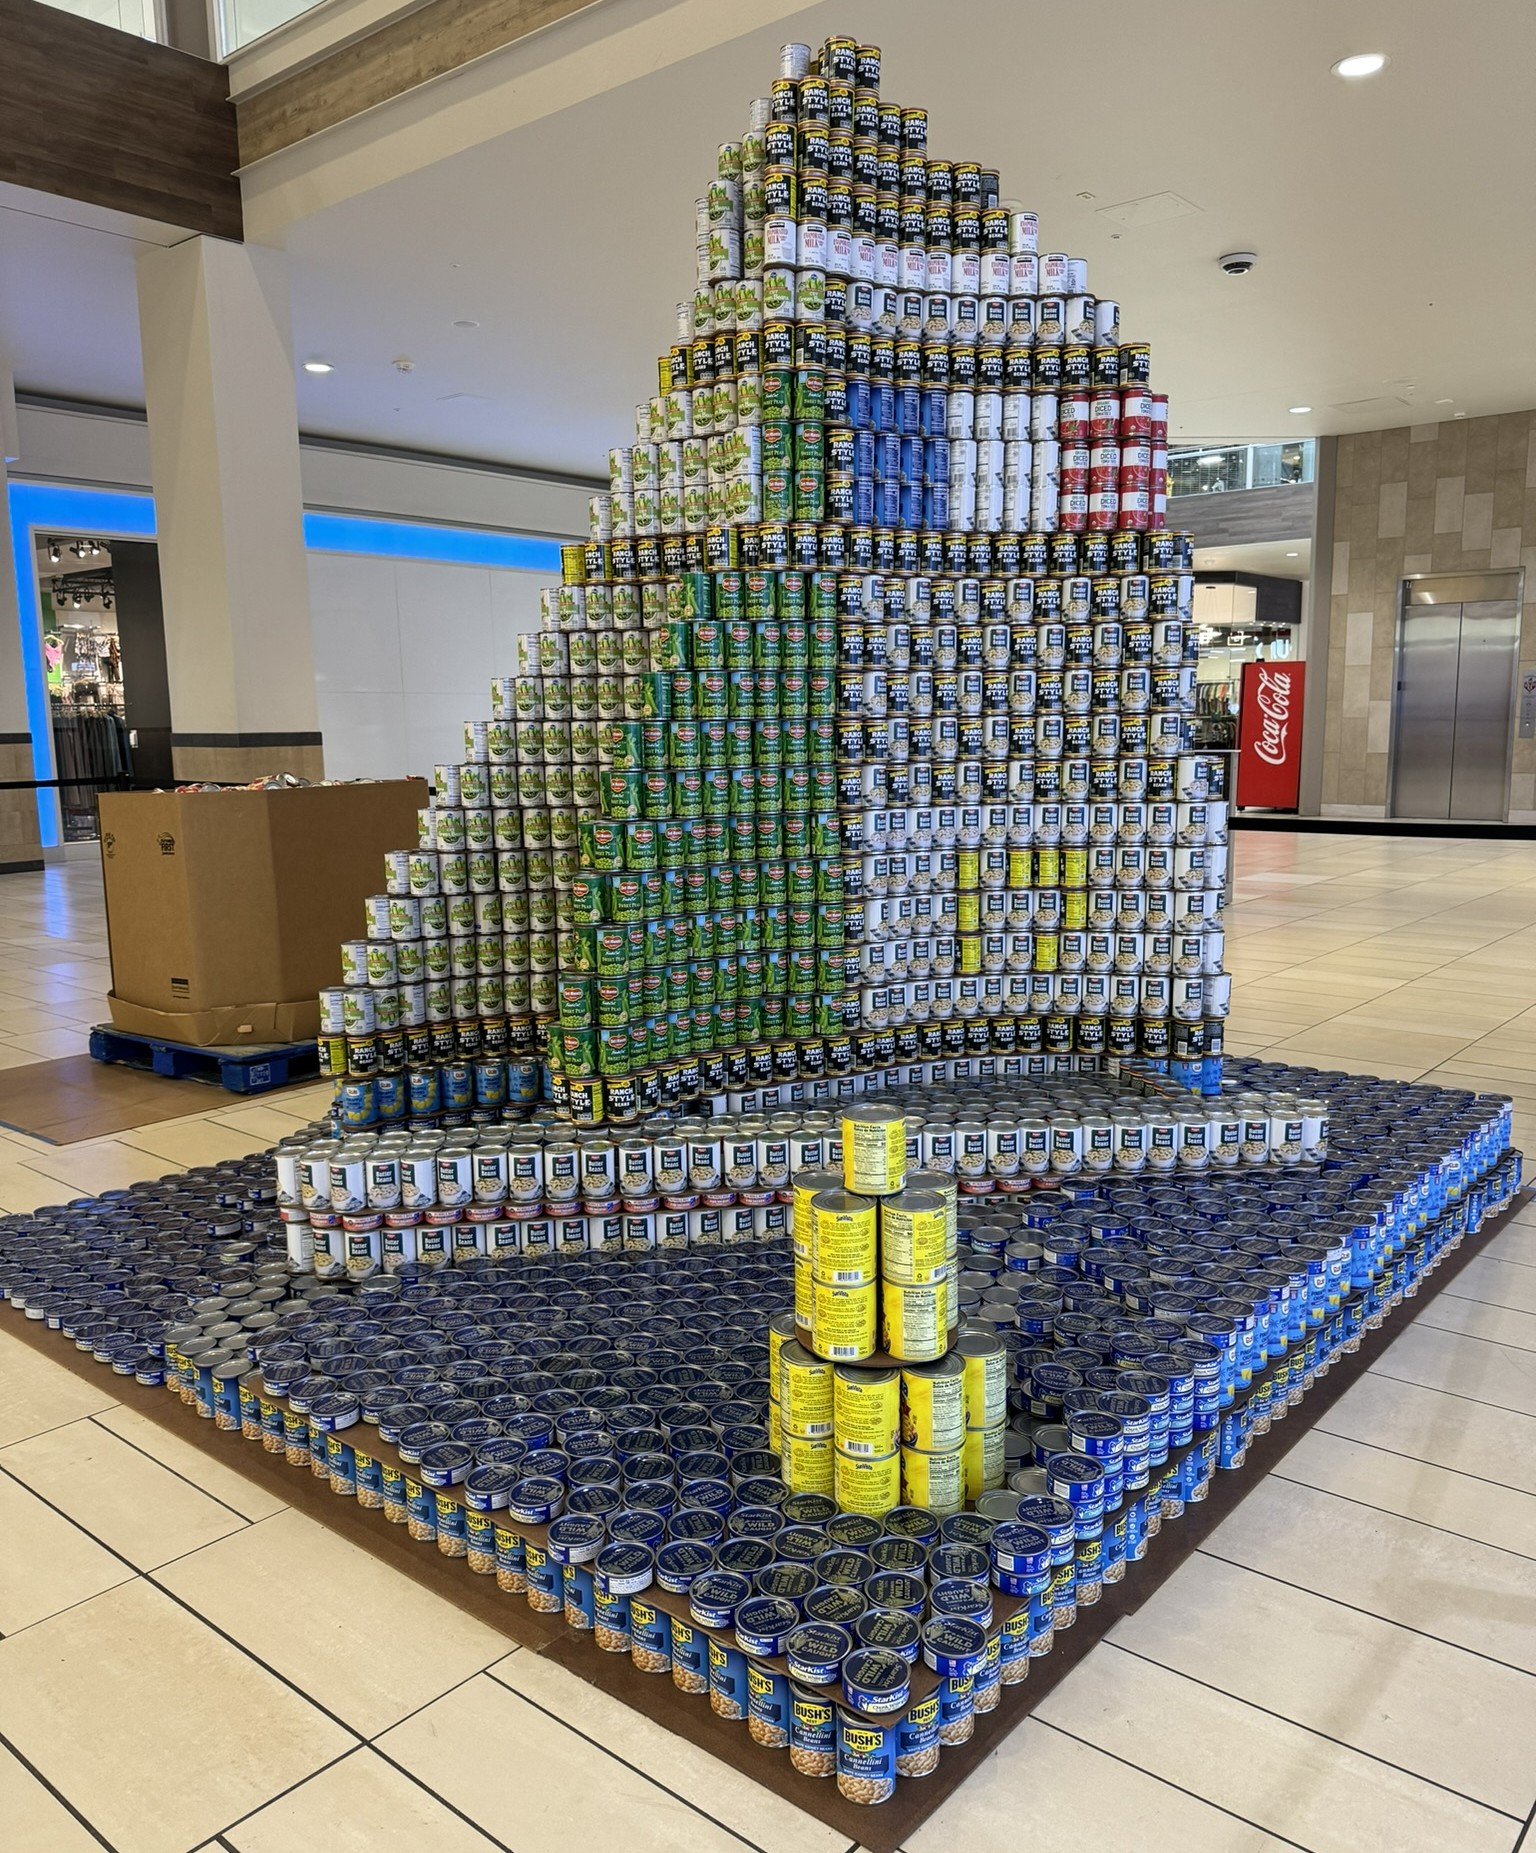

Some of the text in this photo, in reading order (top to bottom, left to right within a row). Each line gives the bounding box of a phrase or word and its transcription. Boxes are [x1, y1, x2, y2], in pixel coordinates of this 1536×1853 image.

[804, 88, 827, 98] RANCH
[802, 96, 829, 105] STYLE
[767, 141, 793, 149] STYLE
[902, 213, 923, 221] RANCH
[900, 220, 925, 228] STYLE
[984, 226, 1008, 234] STYLE
[765, 340, 790, 348] STYLE
[1254, 667, 1291, 766] Coca-Cola
[801, 1507, 829, 1515] WILD
[847, 1525, 874, 1536] WILD
[1012, 1535, 1040, 1547] WILD
[710, 1588, 737, 1599] WILD
[807, 1628, 842, 1641] StarKist
[944, 1632, 973, 1649] WILD
[808, 1641, 838, 1654] WILD
[937, 1637, 970, 1652] CAUGHT
[801, 1646, 837, 1659] CAUGHT
[793, 1662, 825, 1673] StarKist
[854, 1657, 872, 1682] CAUGHT
[861, 1662, 881, 1684] WILD
[872, 1691, 904, 1703] StarKist
[795, 1701, 831, 1720] BUSH'S
[794, 1727, 832, 1739] Cannellini
[845, 1730, 882, 1746] BUSH'S
[803, 1736, 821, 1744] Beans
[844, 1753, 882, 1766] Cannellini
[852, 1762, 872, 1771] Beans
